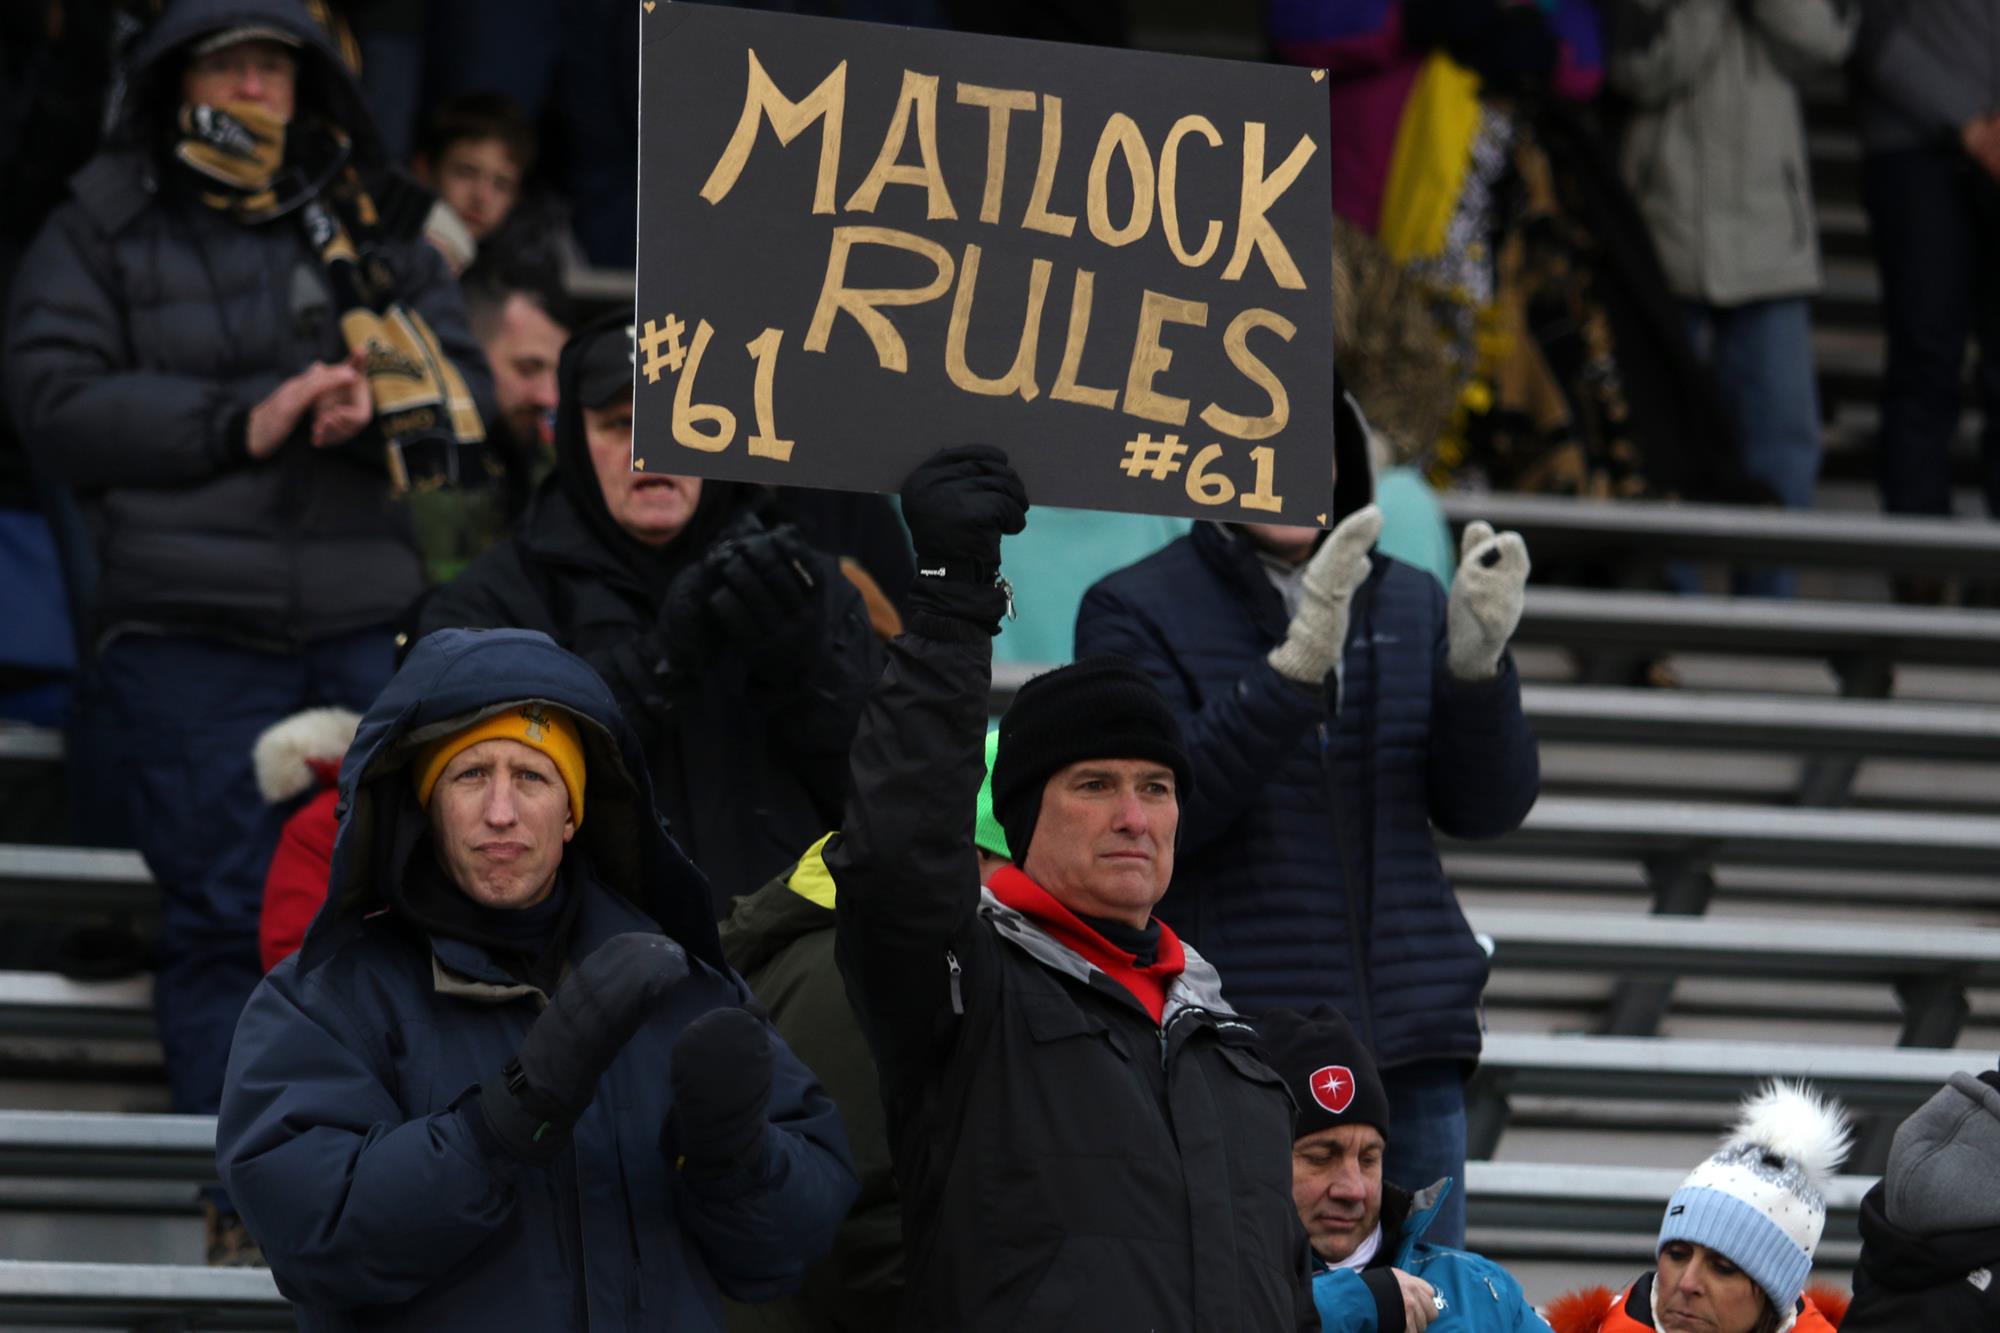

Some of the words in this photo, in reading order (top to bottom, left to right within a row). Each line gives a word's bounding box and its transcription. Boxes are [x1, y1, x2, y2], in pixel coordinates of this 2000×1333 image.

[700, 47, 1317, 289] MATLOCK
[638, 313, 795, 462] #61
[804, 226, 1296, 440] RULES
[1119, 432, 1283, 513] #61
